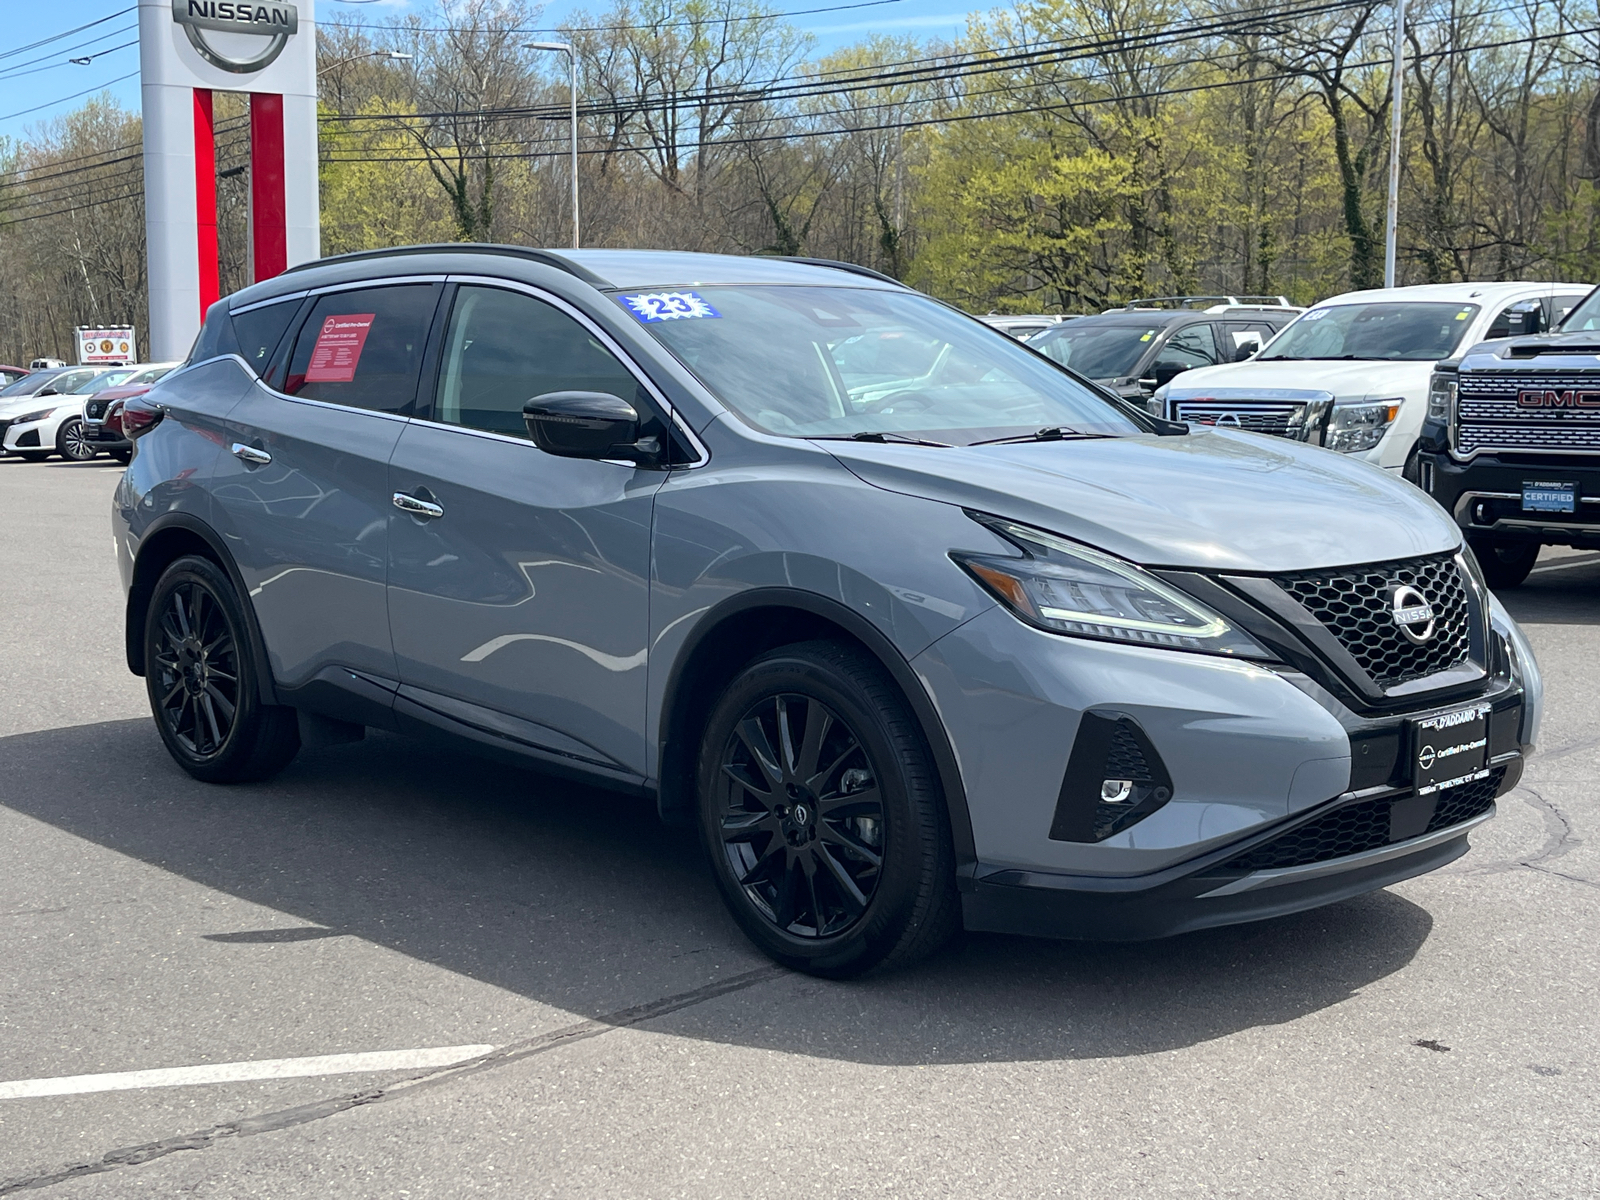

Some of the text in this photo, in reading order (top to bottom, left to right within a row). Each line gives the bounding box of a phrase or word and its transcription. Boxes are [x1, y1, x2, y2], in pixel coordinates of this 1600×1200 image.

[188, 0, 289, 26] NISSAN
[647, 297, 692, 315] 23
[1519, 390, 1600, 407] GMC
[1524, 492, 1574, 502] CERTIFIED
[1395, 609, 1431, 622] NISSA
[1437, 745, 1460, 758] Certified
